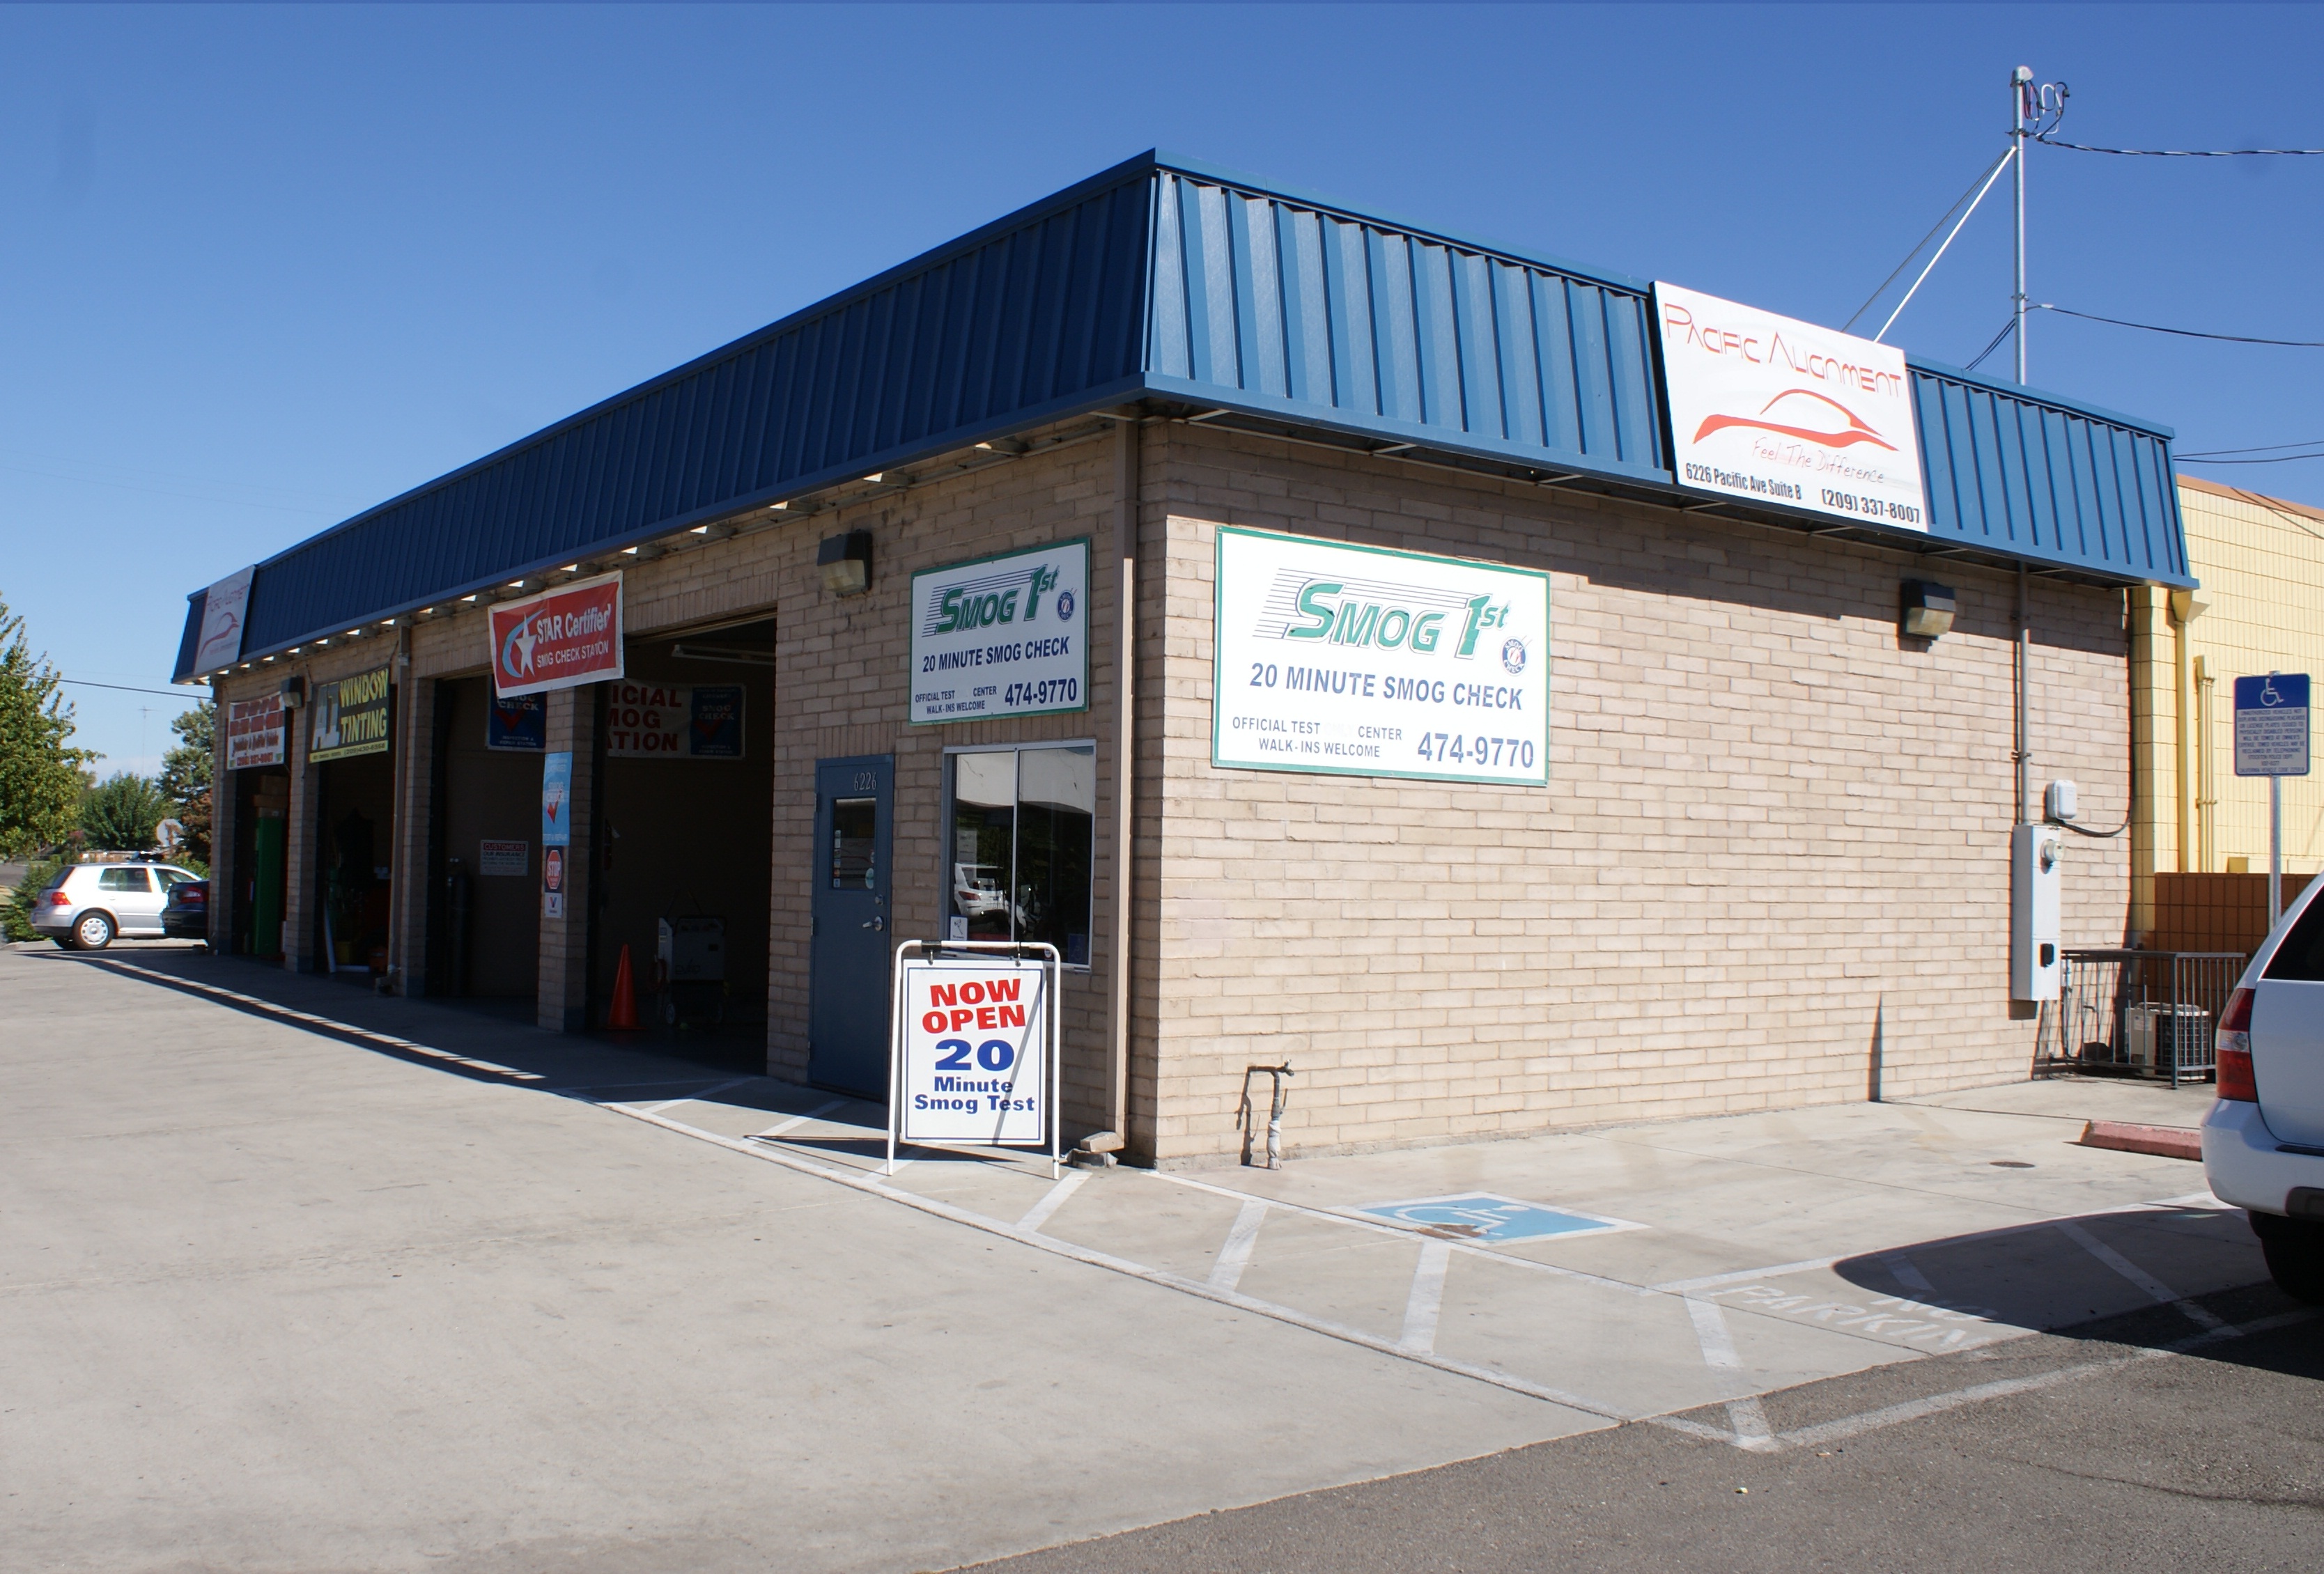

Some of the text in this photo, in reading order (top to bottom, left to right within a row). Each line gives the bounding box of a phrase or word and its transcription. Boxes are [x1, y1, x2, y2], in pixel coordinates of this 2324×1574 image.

[1752, 437, 1885, 484] Feel The Difference
[1686, 462, 1921, 524] 6226 Pacific Ave Suite B (209) 337-8007
[934, 563, 1060, 634] SMOG 1st
[536, 614, 563, 644] STAR
[1283, 579, 1512, 660] SMOG 1st
[555, 645, 581, 664] CHECK
[922, 636, 1070, 673] 20 MINUTE SMOG CHECK
[340, 668, 389, 708] WINDOW
[612, 685, 682, 708] ICIAL
[915, 685, 997, 703] OFFICIAL TEST CENTER
[1005, 678, 1077, 706] 474-9770
[1250, 662, 1523, 710] 20 MINUTE SMOG CHECK
[498, 701, 539, 711] CHECK
[956, 700, 985, 712] WELCOME
[341, 708, 387, 744] TINTING
[1232, 717, 1287, 733] OFFICIAL
[1291, 721, 1321, 735] TEST
[1358, 726, 1402, 741] CENTER
[1324, 742, 1381, 758] WELCOME
[1418, 731, 1534, 769] 474-9770
[854, 772, 877, 791] 6226
[484, 843, 525, 851] CUSTOMERS
[930, 978, 1021, 1008] NOW
[922, 1004, 1026, 1034] OPEN
[935, 1038, 1015, 1071] 20
[934, 1076, 1014, 1093] Minute
[914, 1094, 1035, 1114] Smog Test
